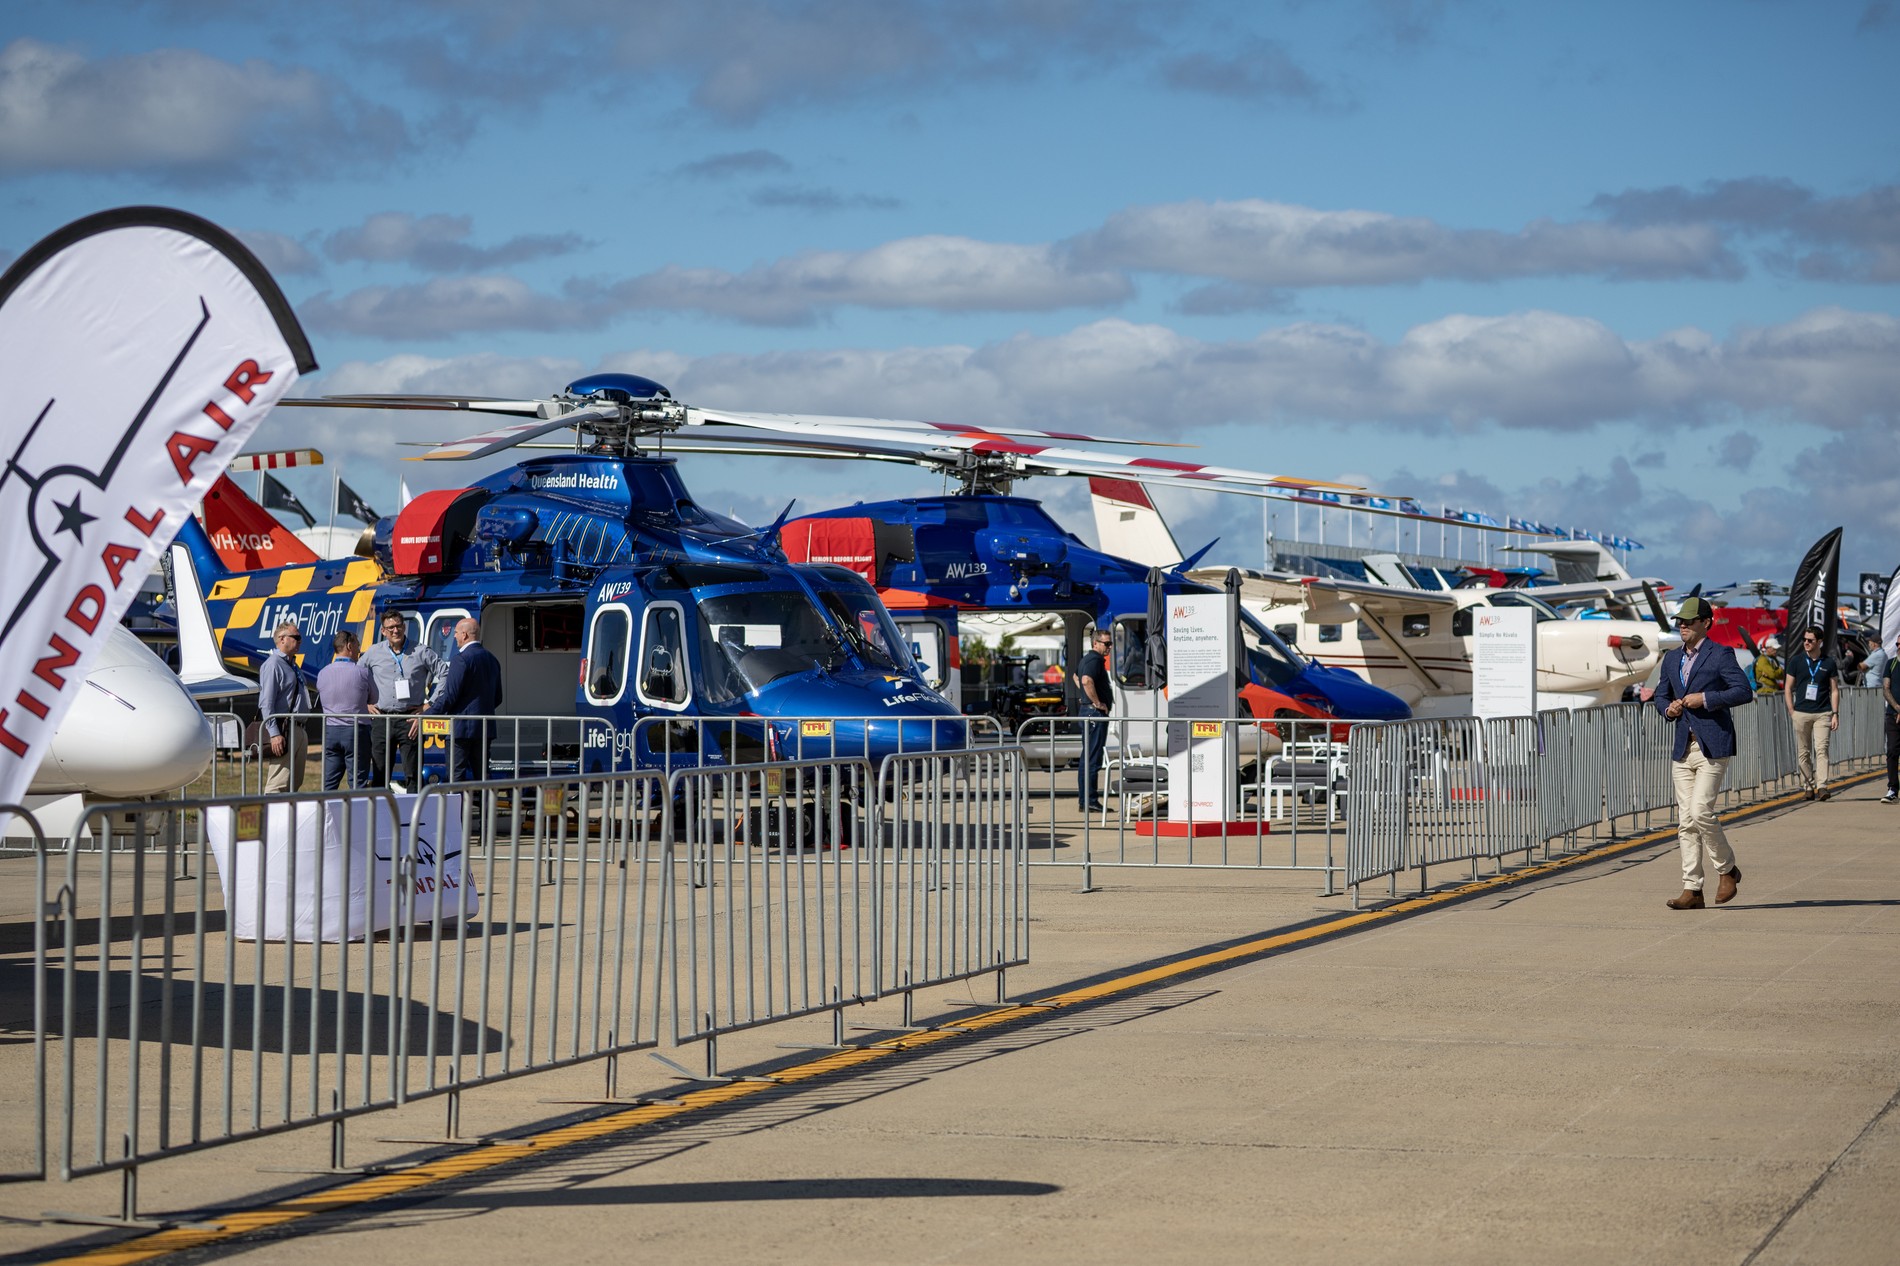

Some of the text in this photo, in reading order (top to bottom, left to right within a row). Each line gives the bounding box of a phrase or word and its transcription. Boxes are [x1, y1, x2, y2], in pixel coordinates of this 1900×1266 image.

[531, 472, 618, 490] Queensland Health
[0, 358, 274, 759] TINDAL AIR
[1813, 570, 1827, 634] DIAK
[1173, 626, 1189, 634] Saving
[426, 721, 445, 729] TFH
[806, 723, 826, 731] TFH
[1196, 724, 1217, 732] TFH
[584, 728, 633, 753] ifeFgh
